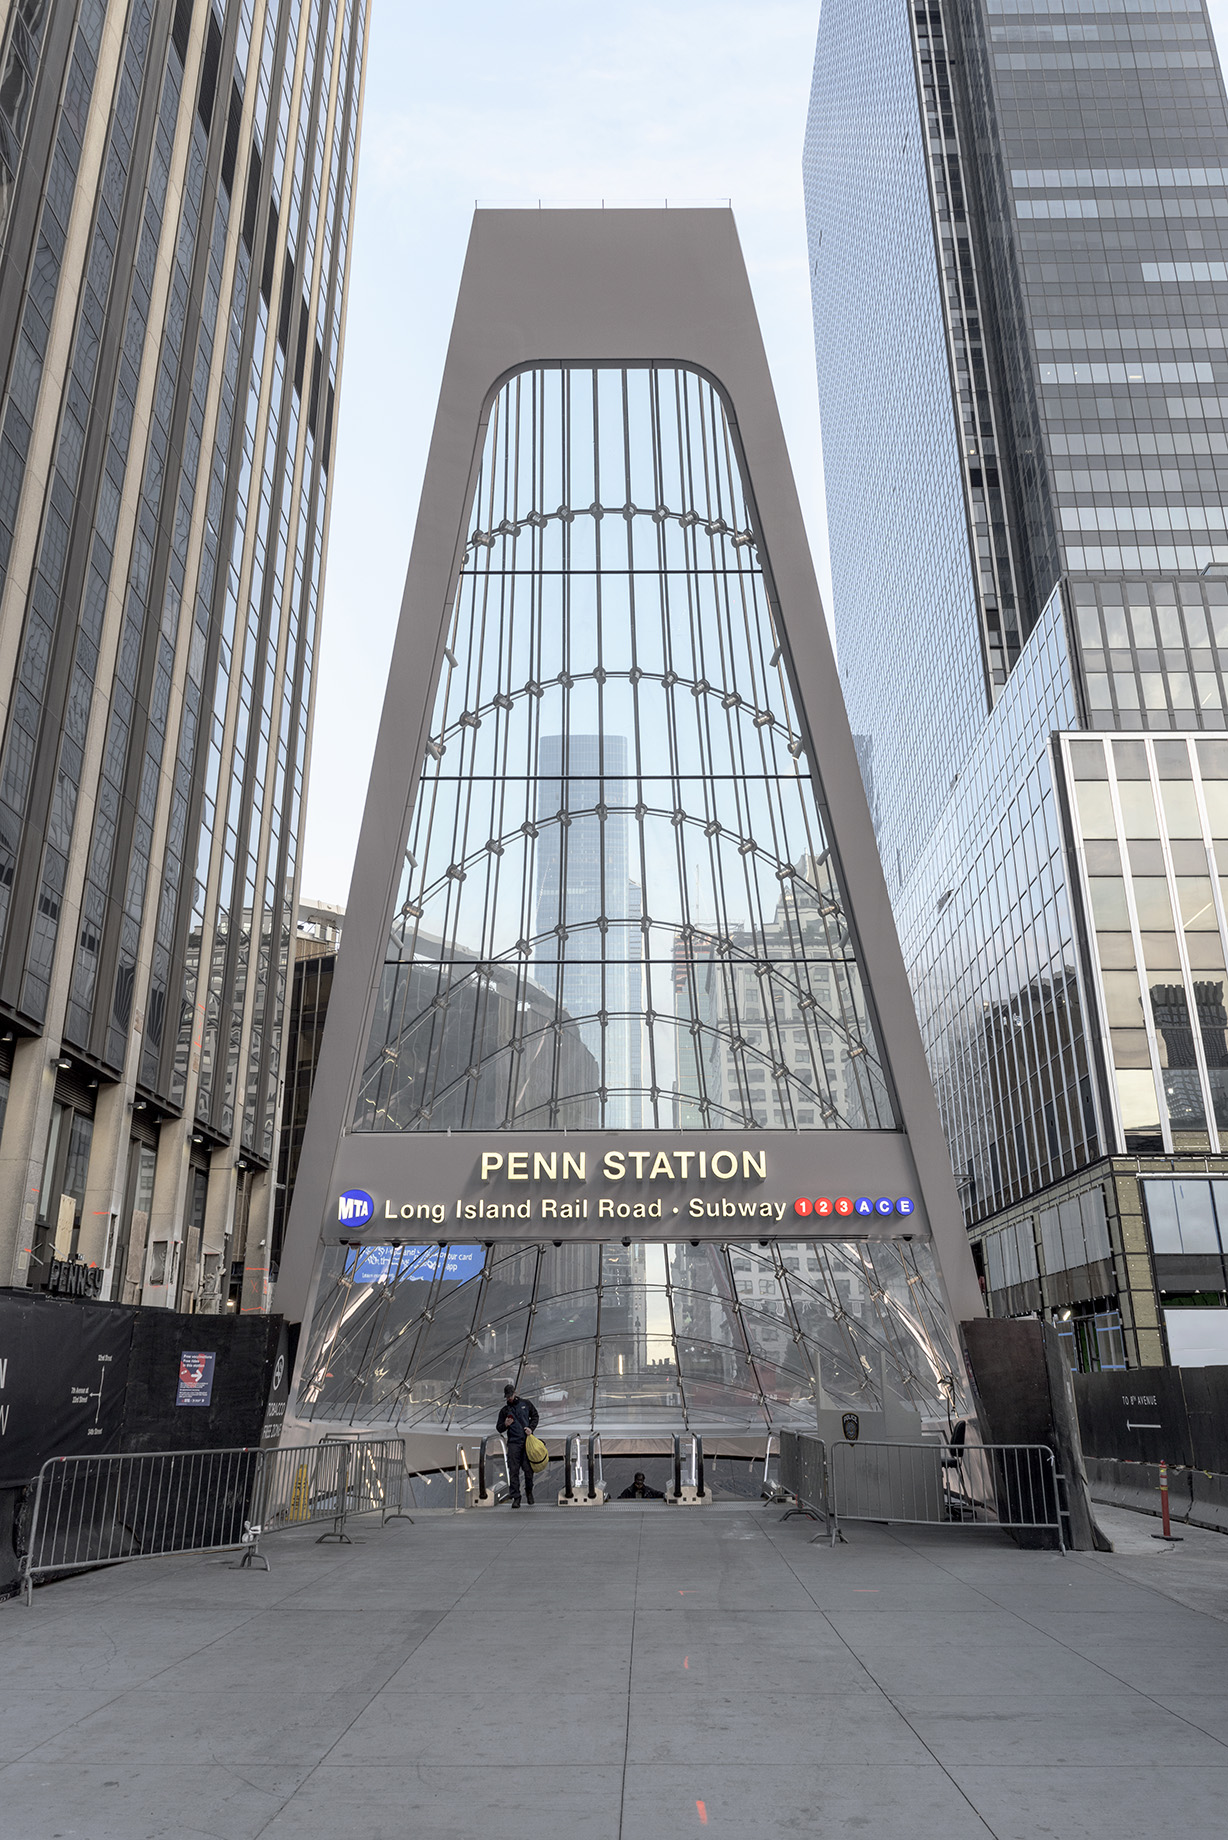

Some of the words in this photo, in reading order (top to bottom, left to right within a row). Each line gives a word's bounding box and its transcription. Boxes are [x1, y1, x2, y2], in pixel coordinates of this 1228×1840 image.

[481, 1151, 586, 1180] PENN
[603, 1150, 767, 1180] STATION
[337, 1196, 369, 1221] MTA
[384, 1199, 445, 1224] Long
[456, 1199, 531, 1219] Island
[541, 1199, 588, 1219] Rail
[598, 1198, 662, 1218] Road
[689, 1197, 787, 1221] Subway
